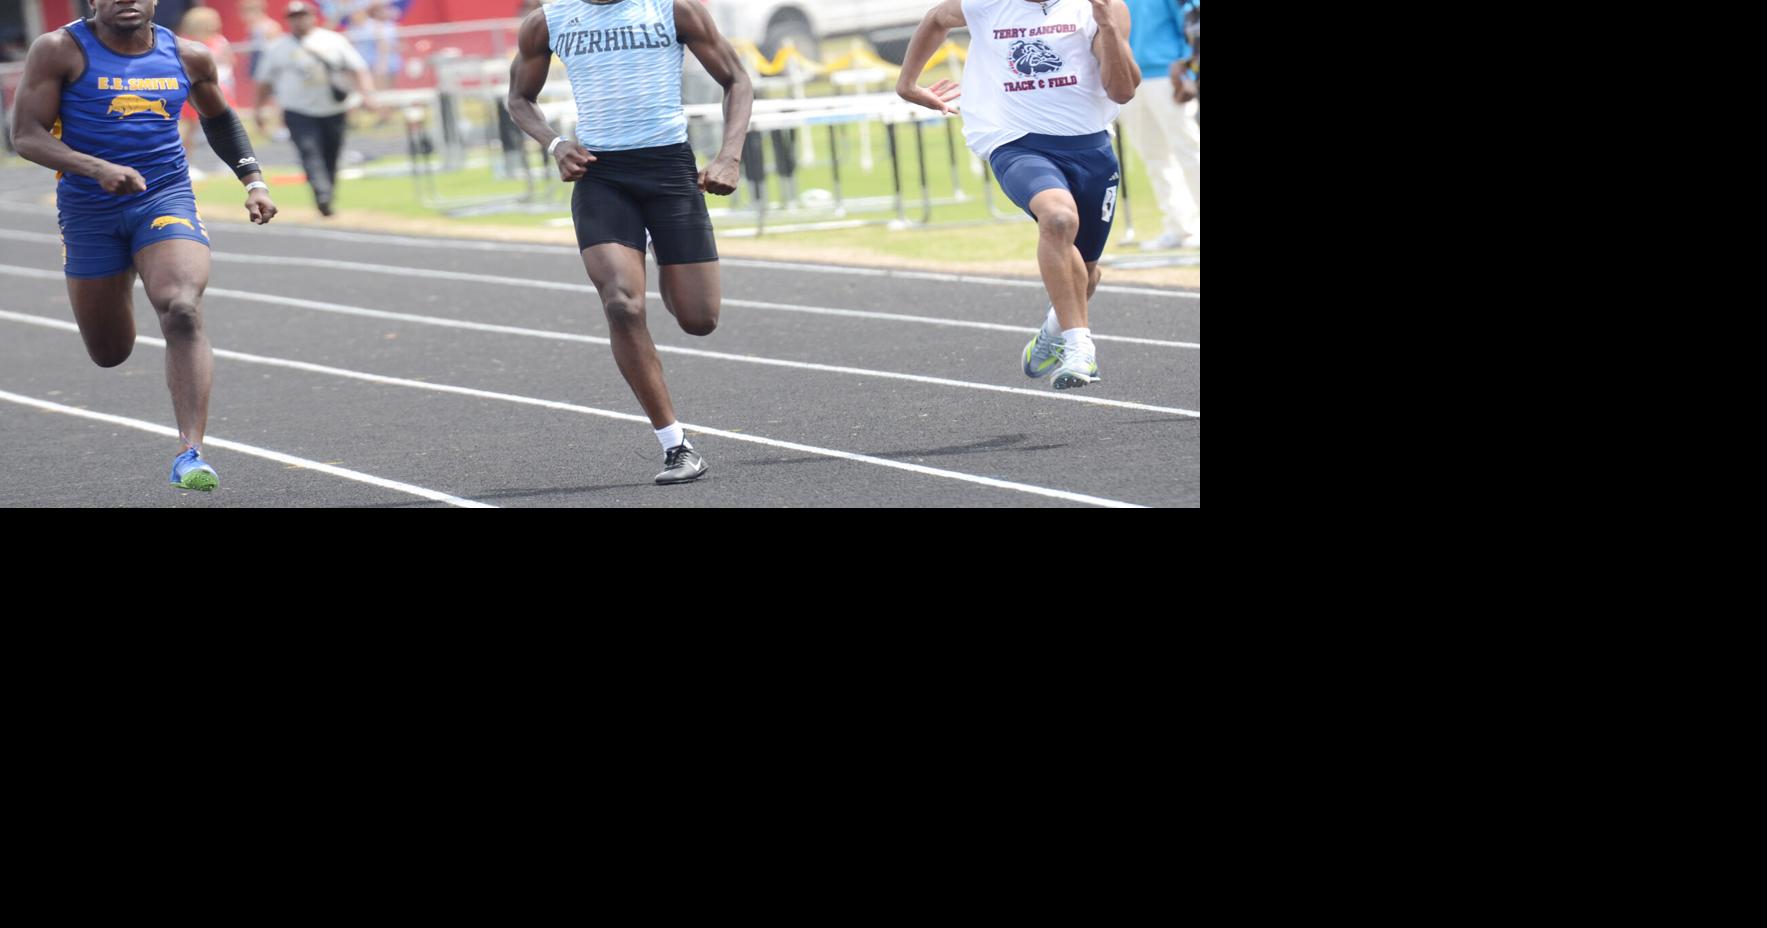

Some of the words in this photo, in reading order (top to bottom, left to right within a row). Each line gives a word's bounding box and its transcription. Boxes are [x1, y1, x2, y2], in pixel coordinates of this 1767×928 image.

[556, 22, 671, 58] OVERHILLS
[993, 28, 1027, 39] TERRY
[1029, 24, 1076, 36] SANFORD
[1004, 80, 1036, 92] TRACK
[1048, 75, 1077, 88] FIELD
